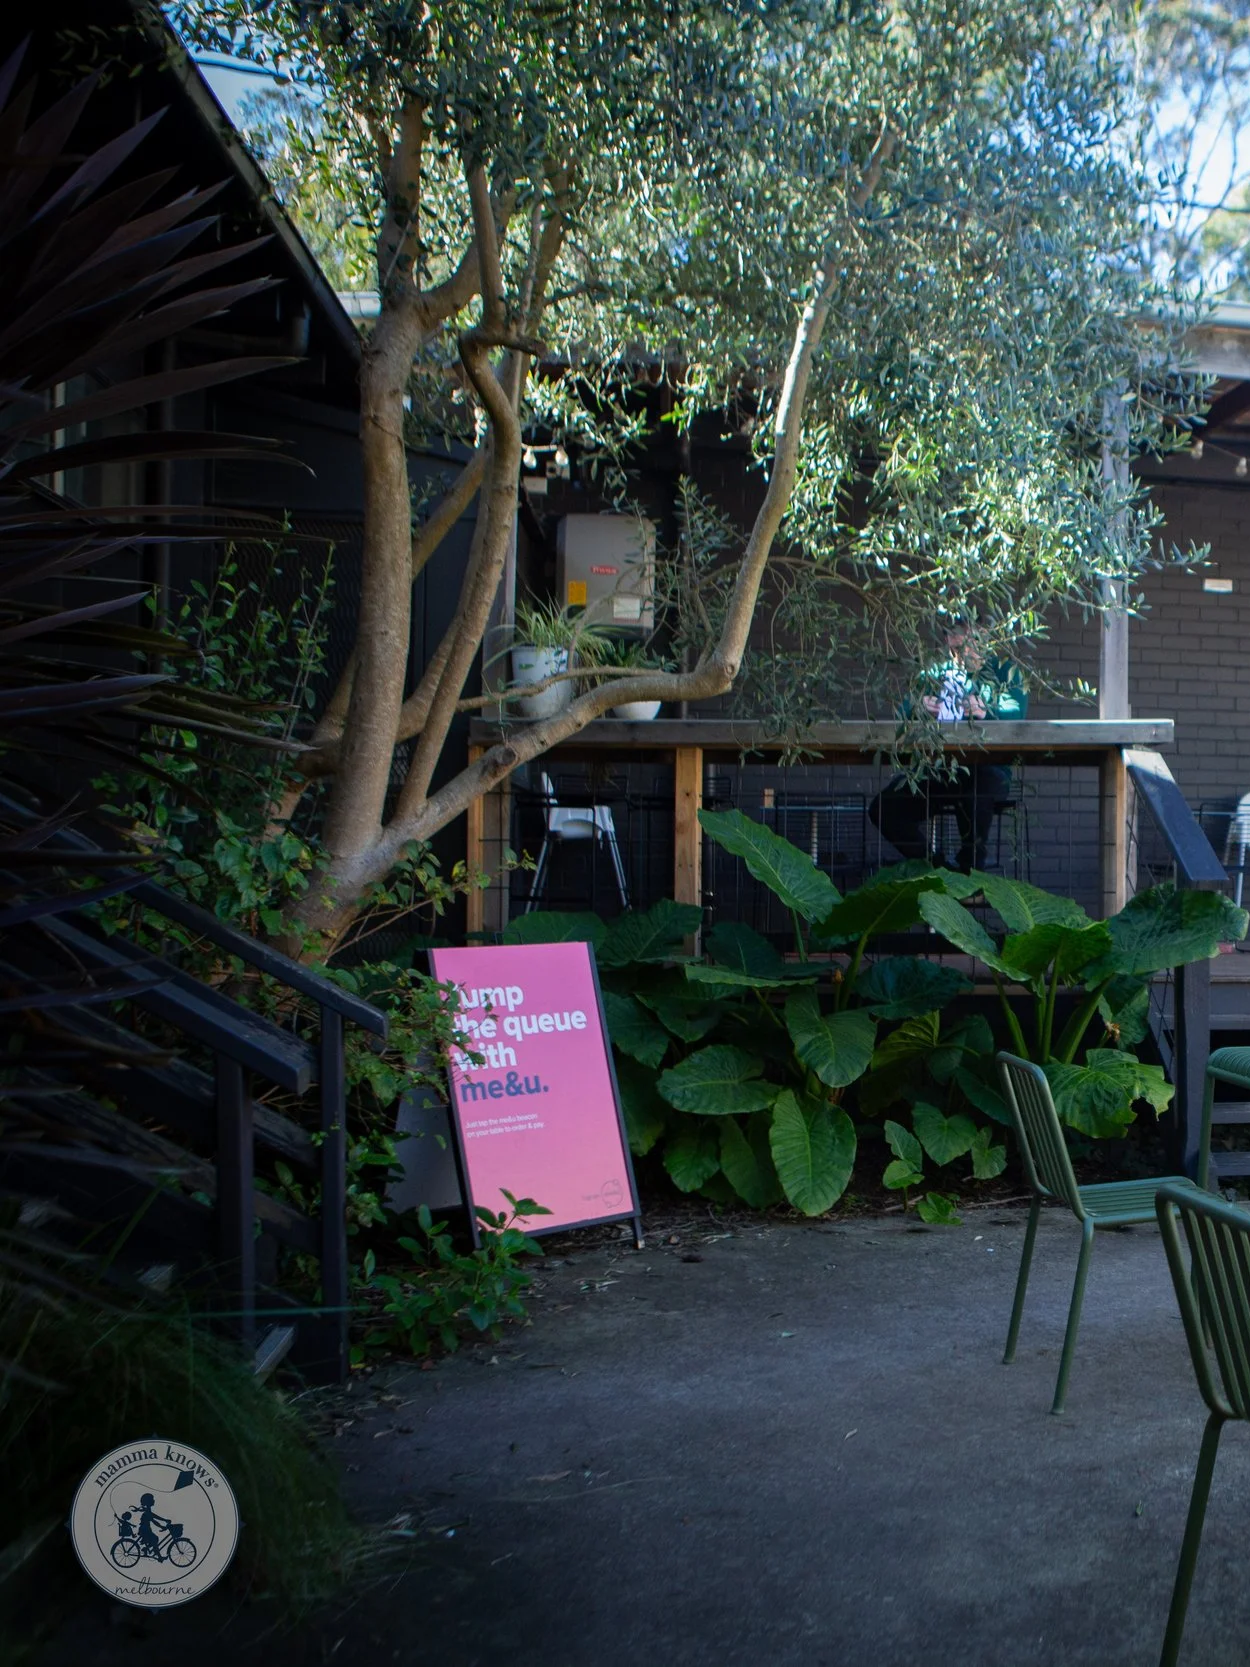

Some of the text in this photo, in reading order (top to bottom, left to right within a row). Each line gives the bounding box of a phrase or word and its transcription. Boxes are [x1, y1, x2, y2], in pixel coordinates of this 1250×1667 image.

[452, 984, 524, 1012] ump
[503, 1009, 587, 1041] queue
[460, 1071, 549, 1103] me&u.
